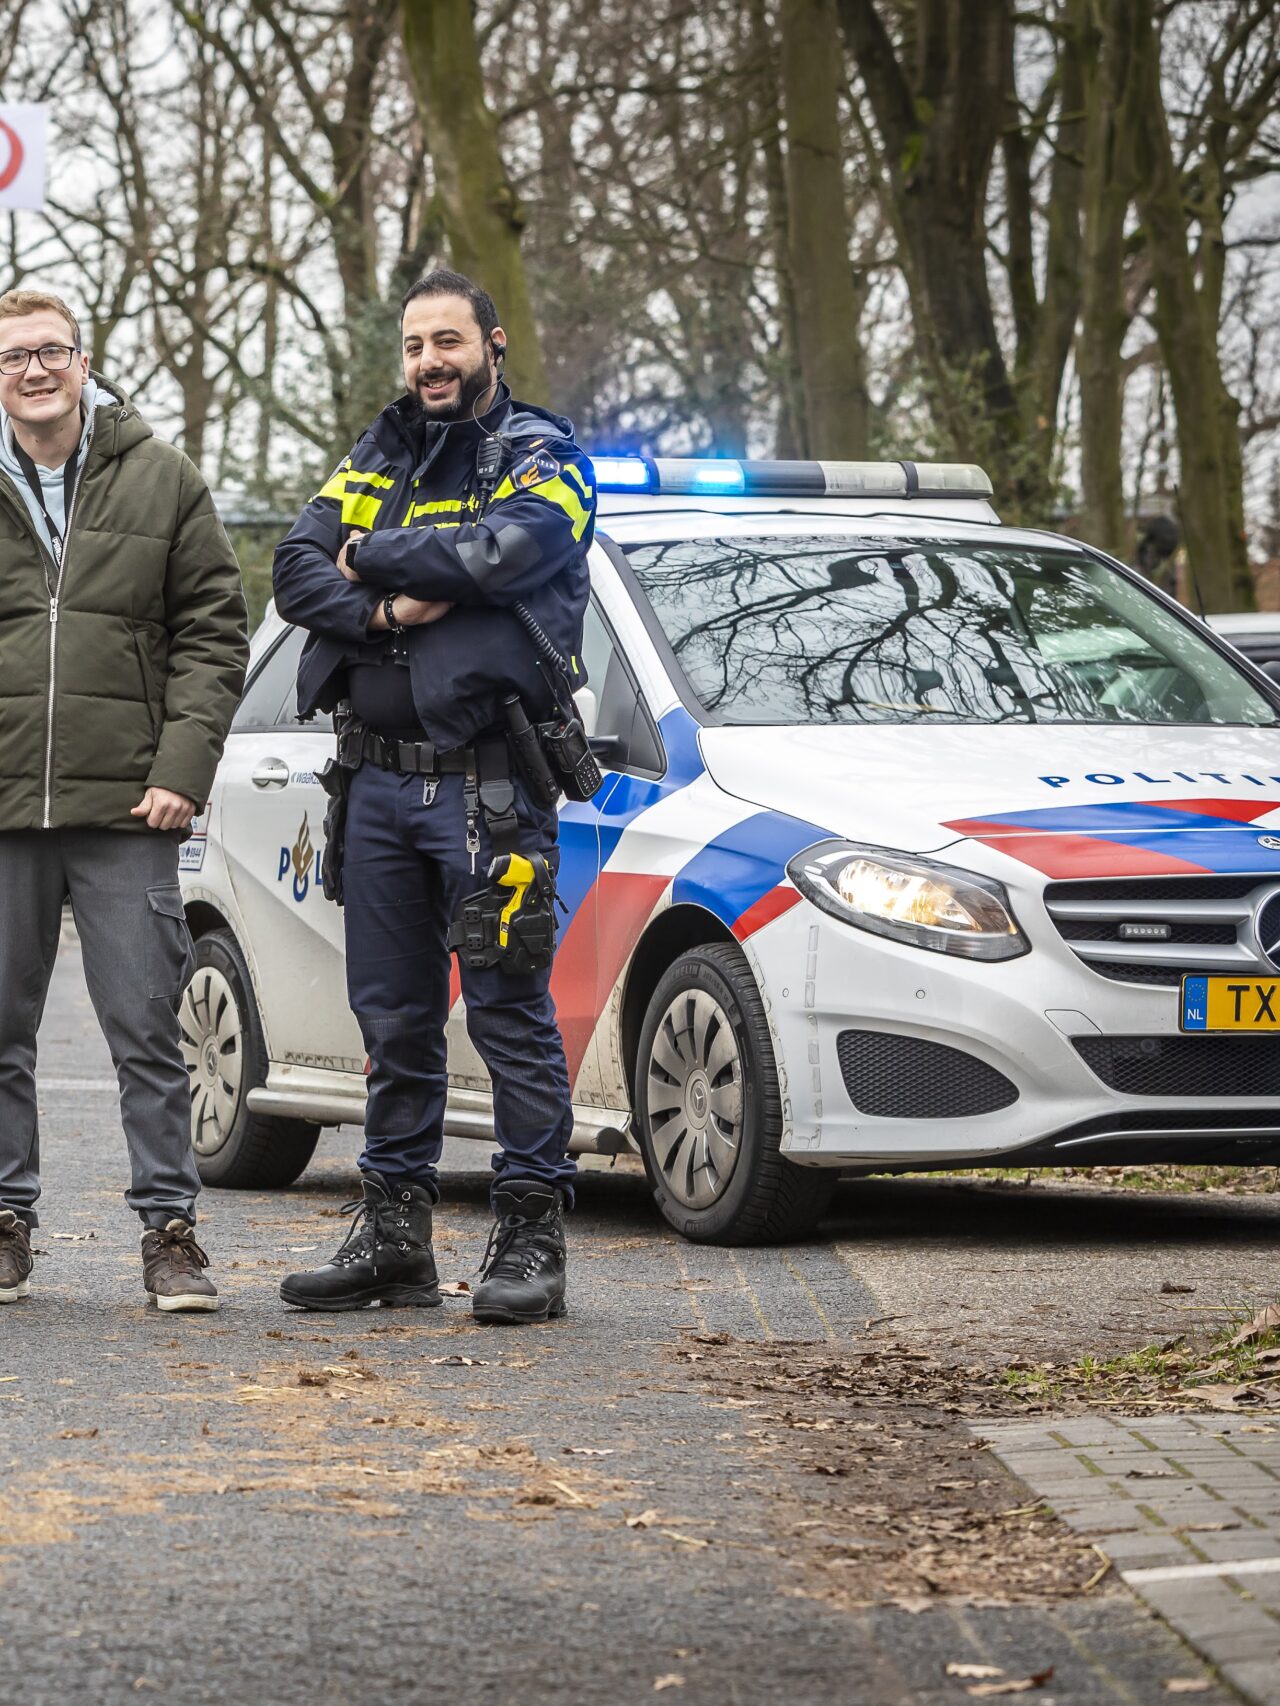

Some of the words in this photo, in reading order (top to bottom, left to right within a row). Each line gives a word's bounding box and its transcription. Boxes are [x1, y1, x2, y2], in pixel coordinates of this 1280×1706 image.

[1038, 771, 1280, 788] POLITI
[1227, 984, 1277, 1022] TX
[1187, 1008, 1204, 1020] NL
